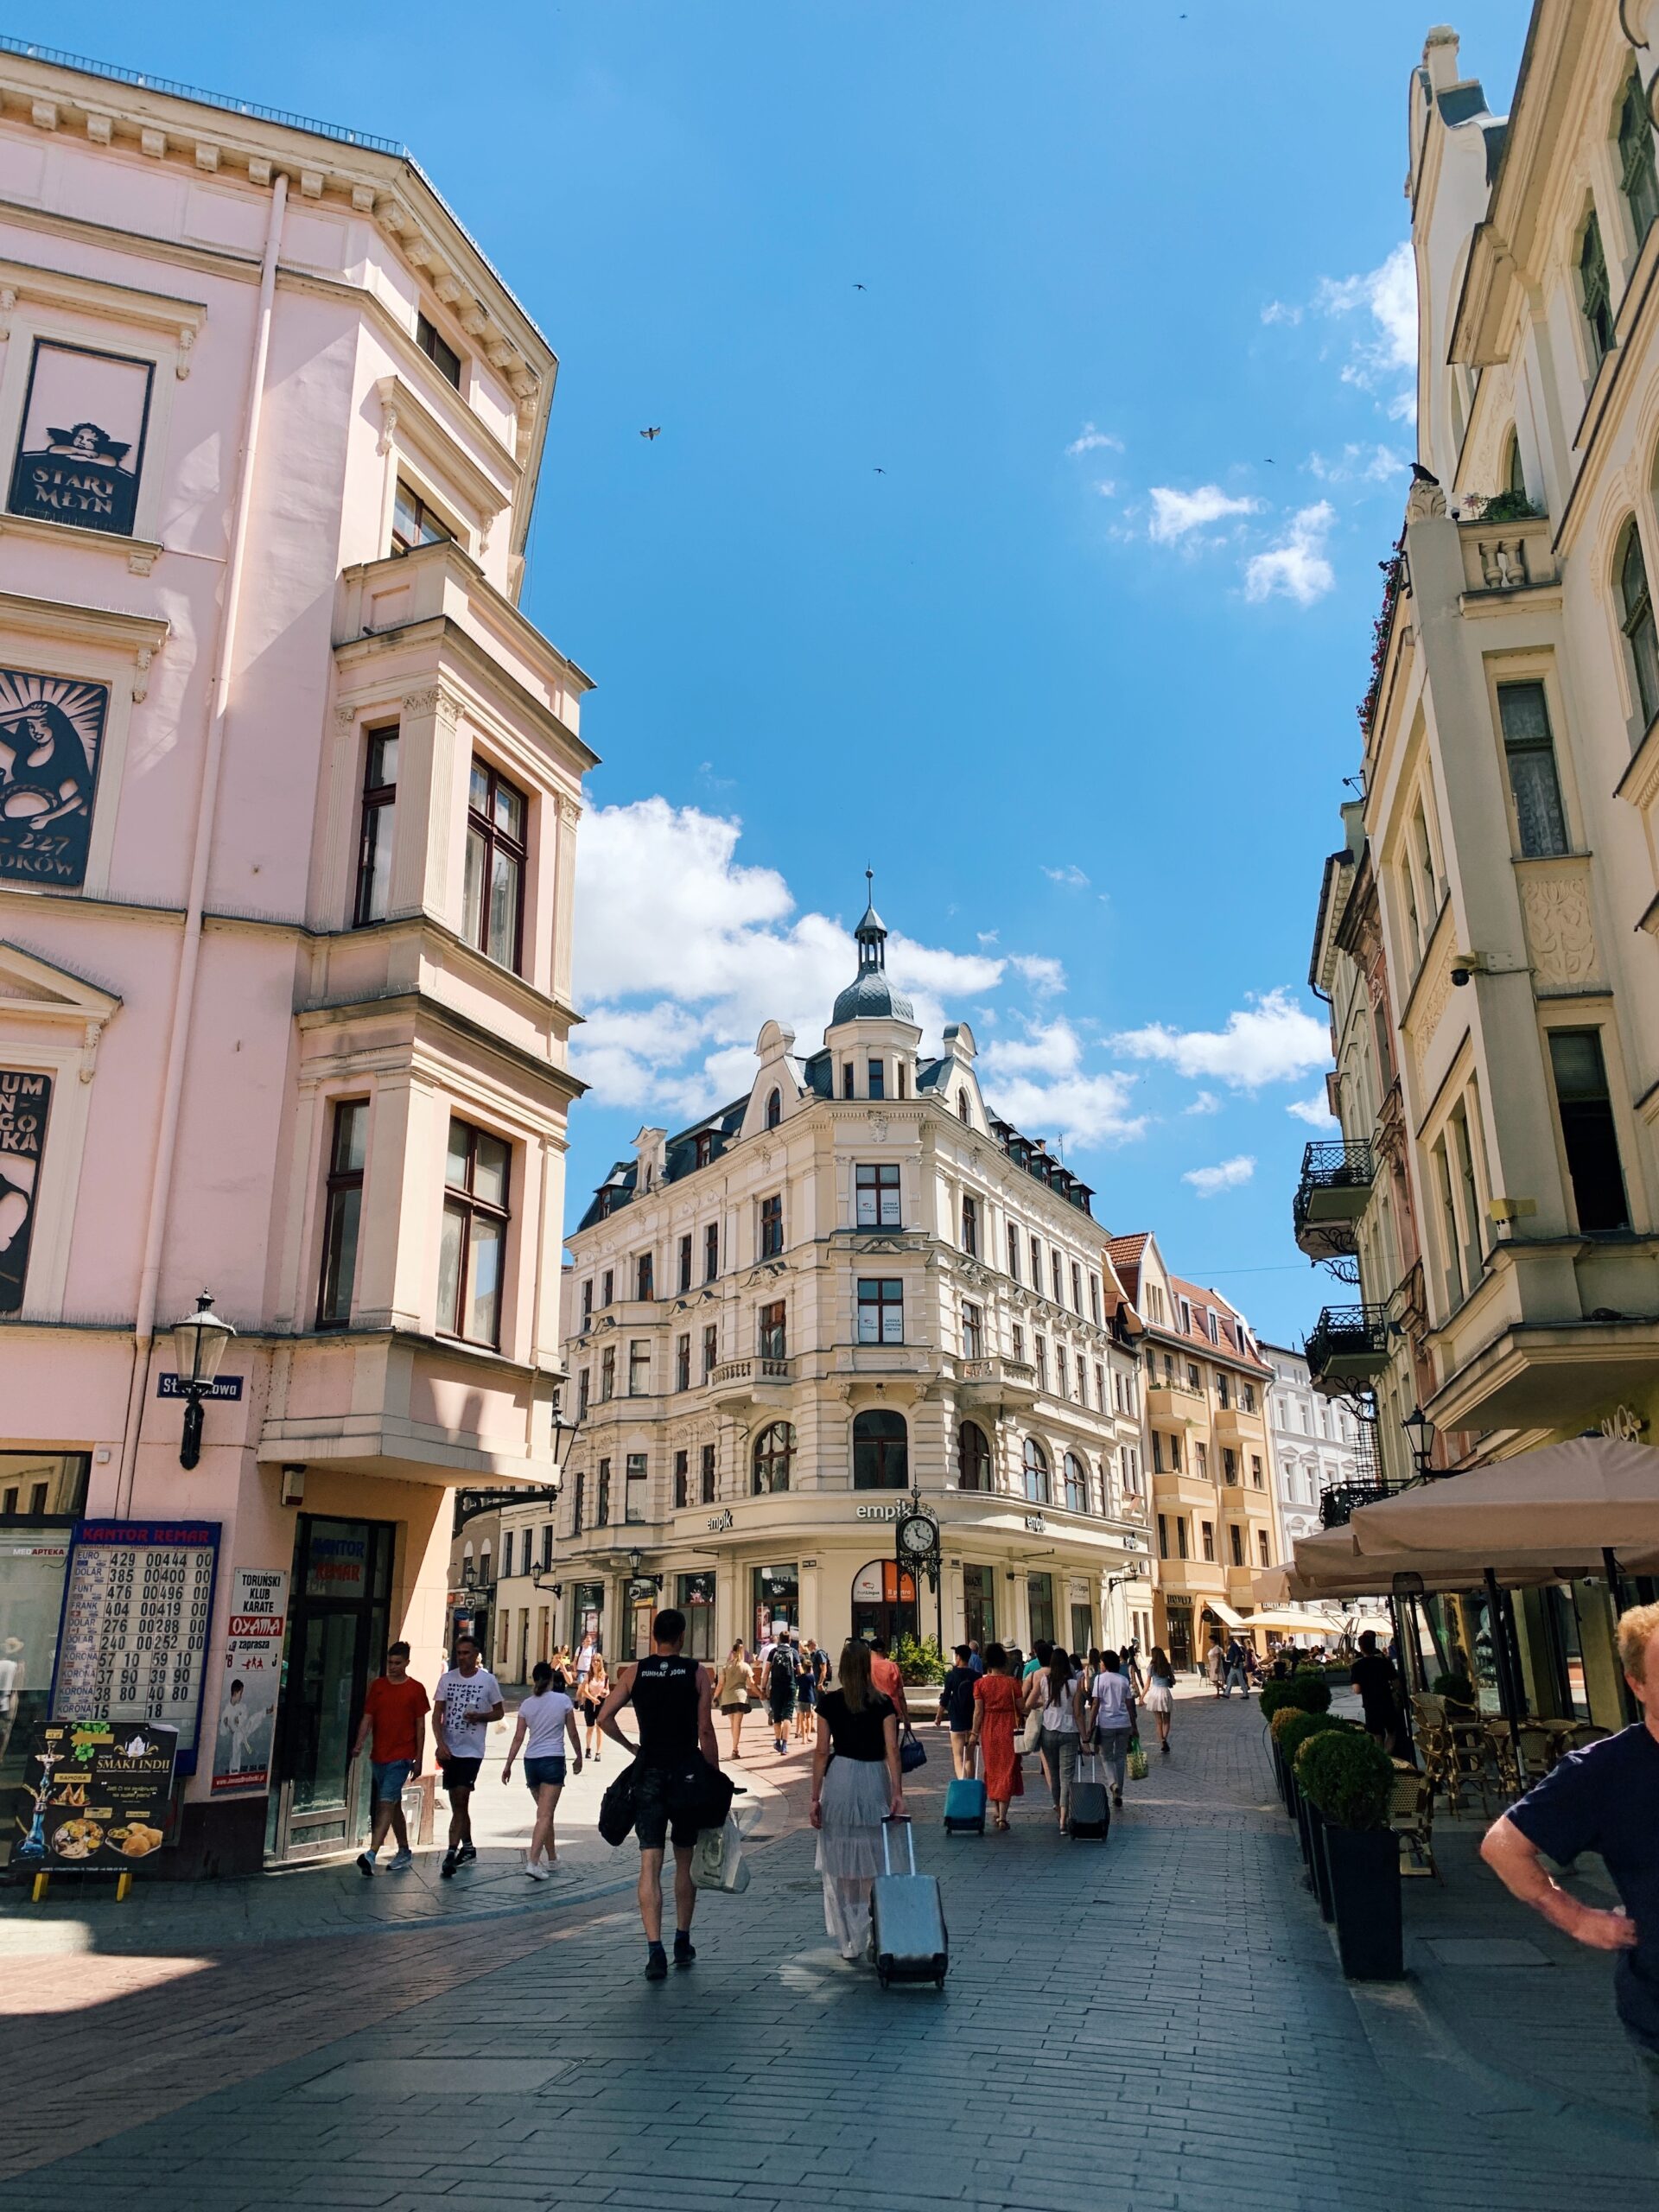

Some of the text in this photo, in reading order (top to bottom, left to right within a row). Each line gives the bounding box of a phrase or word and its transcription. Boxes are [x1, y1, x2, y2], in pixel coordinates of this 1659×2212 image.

[35, 484, 112, 515] MŁYN
[17, 832, 70, 855] 227
[0, 1131, 38, 1152] KA
[707, 1510, 733, 1532] empik
[83, 1529, 209, 1543] KANTOR REMAR
[111, 1553, 135, 1566] 429
[146, 1554, 162, 1567] 00
[163, 1554, 187, 1567] 444
[196, 1554, 211, 1567] 00
[110, 1569, 133, 1583] 385
[144, 1569, 159, 1583] 00
[161, 1570, 184, 1583] 400
[195, 1570, 210, 1583] 00
[242, 1573, 280, 1587] TORUŃSKI
[108, 1586, 131, 1599] 476
[143, 1586, 158, 1599] 00
[160, 1586, 183, 1599] 496
[194, 1586, 208, 1599] 00
[250, 1588, 270, 1599] KLUB
[105, 1602, 129, 1616] 404
[141, 1602, 156, 1616] 00
[157, 1603, 181, 1616] 419
[191, 1603, 207, 1616] 00
[243, 1601, 274, 1612] KARATE
[103, 1619, 127, 1633] 276
[139, 1619, 154, 1633] 00
[156, 1619, 179, 1633] 288
[190, 1619, 204, 1633] 00
[232, 1617, 280, 1634] OYAMA
[101, 1636, 125, 1649] 240
[137, 1636, 152, 1649] 00
[154, 1636, 178, 1649] 252
[188, 1636, 203, 1649] 00
[238, 1640, 270, 1651] zaprasza
[99, 1653, 115, 1667] 57
[125, 1653, 139, 1667] 10
[153, 1653, 168, 1666] 59
[177, 1653, 191, 1667] 10
[98, 1670, 114, 1684] 37
[121, 1670, 137, 1684] 90
[150, 1670, 165, 1684] 39
[174, 1669, 190, 1683] 90
[60, 1687, 188, 1701] KORONA 38 80 40 80
[58, 1704, 162, 1719] KORONA 15 18
[97, 1759, 170, 1770] SMAKI INDII
